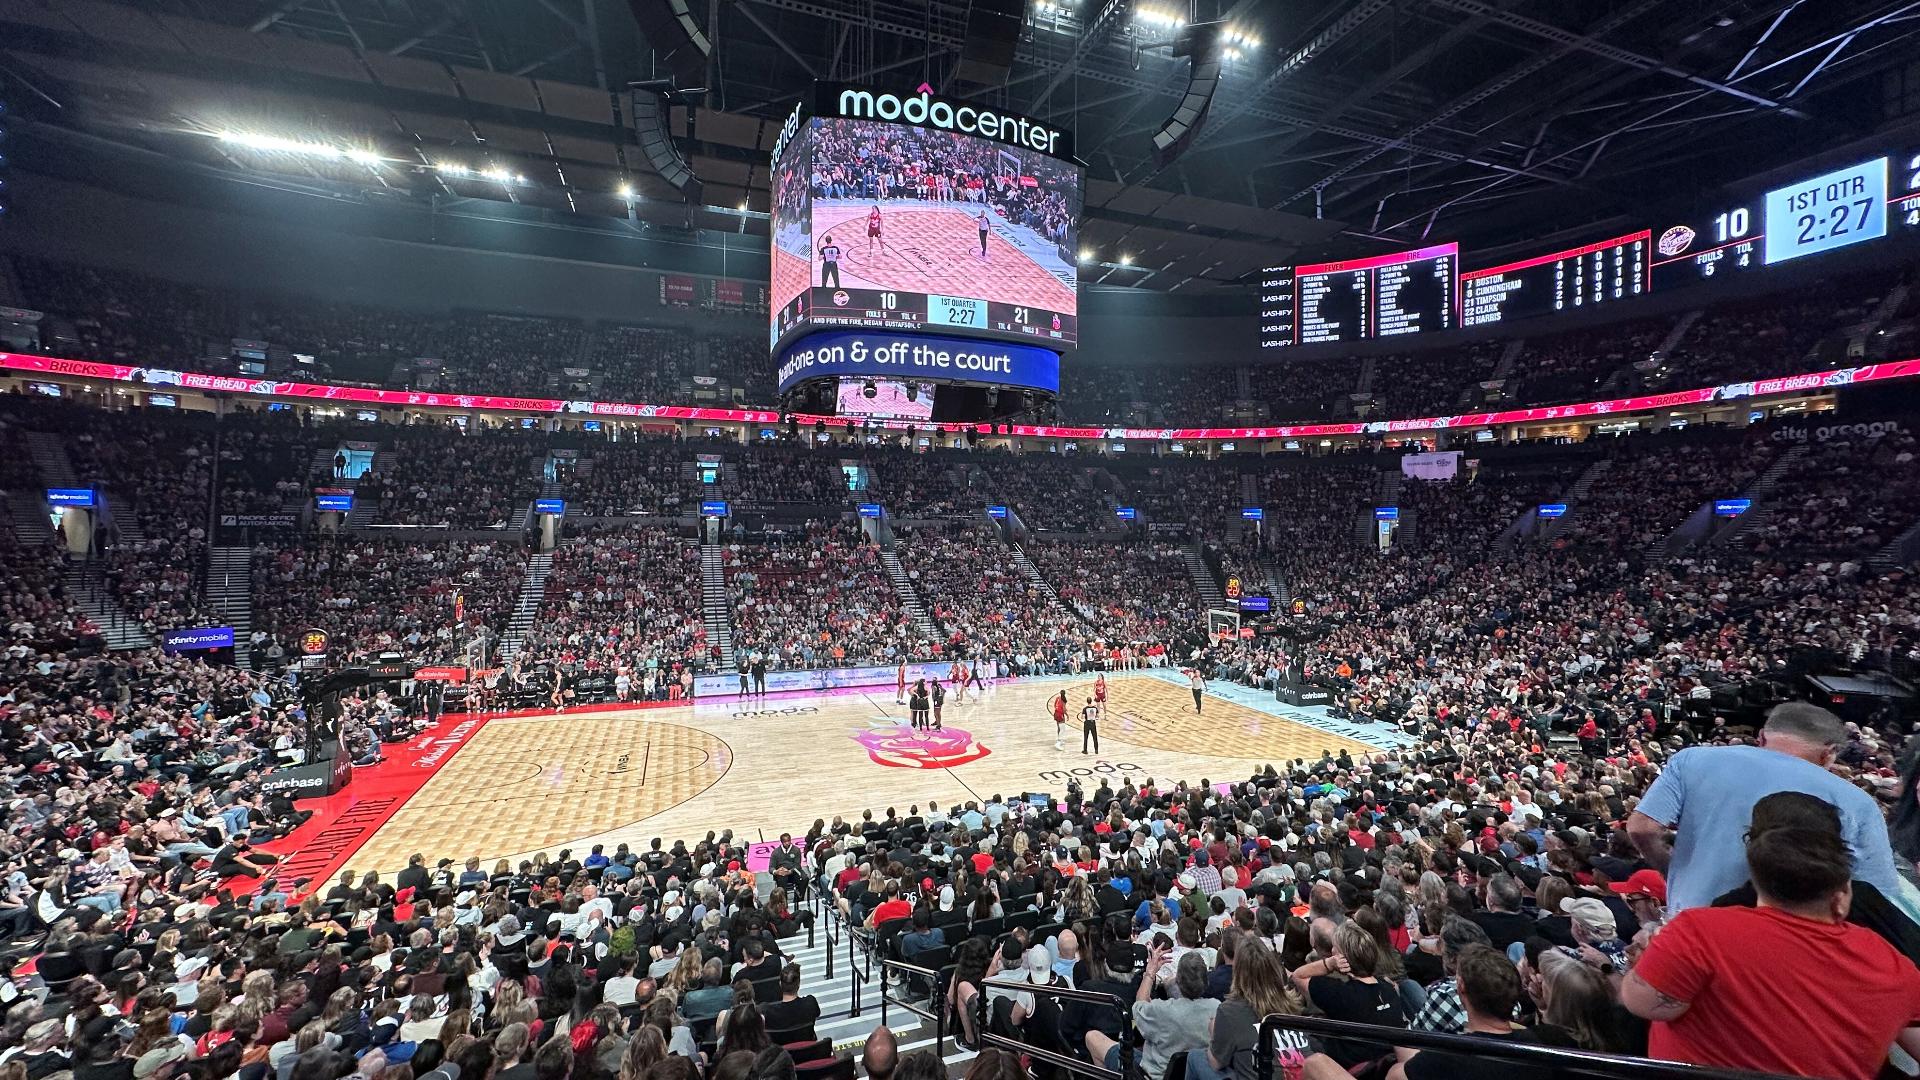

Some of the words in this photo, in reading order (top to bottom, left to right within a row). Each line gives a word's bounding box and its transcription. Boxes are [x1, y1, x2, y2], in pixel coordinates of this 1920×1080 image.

[1787, 188, 1821, 212] 1ST
[1826, 176, 1865, 201] QTR
[1797, 196, 1874, 245] 2:27
[1906, 209, 1919, 225] 4
[1715, 207, 1749, 242] 10
[1736, 242, 1753, 254] TOL
[1406, 251, 1420, 260] FIRE
[1697, 249, 1723, 264] FOULS
[1739, 255, 1749, 267] 4
[1705, 263, 1715, 276] 5
[1476, 274, 1504, 287] BOSTON
[1476, 279, 1522, 296] CUNNINGHAM
[880, 292, 896, 310] 10
[941, 298, 951, 306] 1ST
[952, 298, 976, 308] QUARTER
[1262, 294, 1292, 303] LASHIFY
[1464, 298, 1474, 306] 21
[1476, 292, 1506, 305] TIMPSON
[949, 308, 975, 325] 2:27
[1014, 307, 1028, 324] 21
[1262, 309, 1292, 318] LASHIFY
[1465, 307, 1474, 316] 22
[1476, 304, 1498, 315] CLARK
[1476, 312, 1501, 324] HARRIS
[817, 346, 844, 364] on
[850, 341, 869, 363] &
[874, 342, 909, 364] off
[913, 345, 949, 368] the
[955, 352, 1011, 373] court
[49, 360, 99, 375] BRICKS
[186, 375, 213, 388] FREE
[213, 378, 247, 391] BREAD
[1758, 381, 1783, 393] FREE
[1784, 376, 1821, 389] BREAD
[513, 400, 543, 409] BRICKS
[1656, 393, 1690, 406] BRICKS
[596, 404, 613, 413] FREE
[614, 405, 637, 414] BREAD
[1322, 425, 1346, 434] BRICKS
[1391, 421, 1407, 431] FREE
[1407, 420, 1430, 430] BREAD
[168, 635, 198, 645] xfinity
[199, 633, 229, 642] mobile
[307, 643, 322, 651] 22
[1038, 762, 1143, 781] moda
